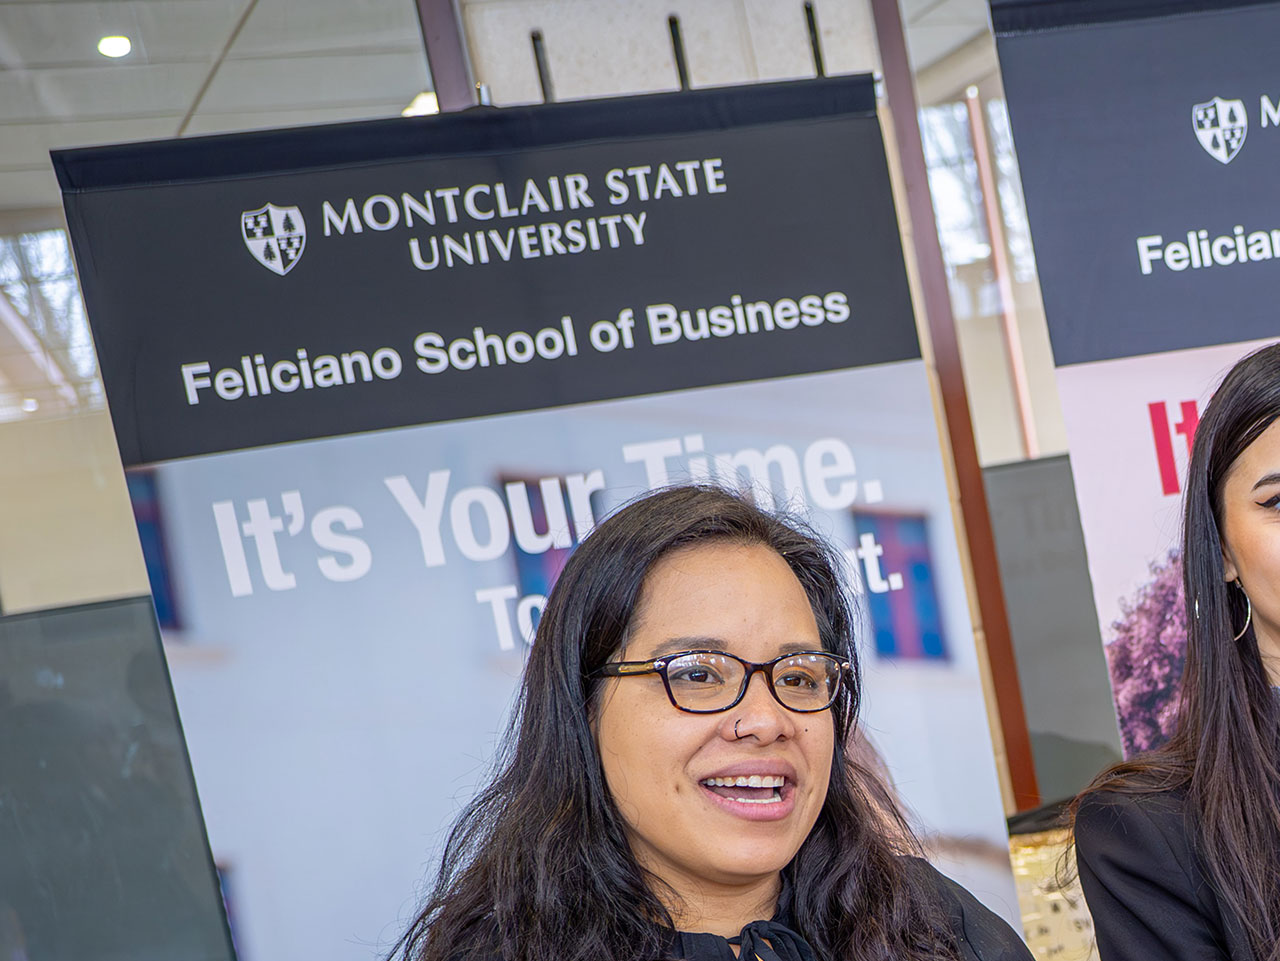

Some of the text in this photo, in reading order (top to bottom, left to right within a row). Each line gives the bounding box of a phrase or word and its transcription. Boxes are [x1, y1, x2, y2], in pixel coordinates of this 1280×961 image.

[323, 158, 727, 237] MONTCLAIR STATE
[409, 212, 648, 270] UNIVERSITY
[181, 292, 850, 405] Feliciano School of Business
[1148, 396, 1205, 496] It
[212, 488, 372, 598] It's
[384, 467, 605, 567] Your
